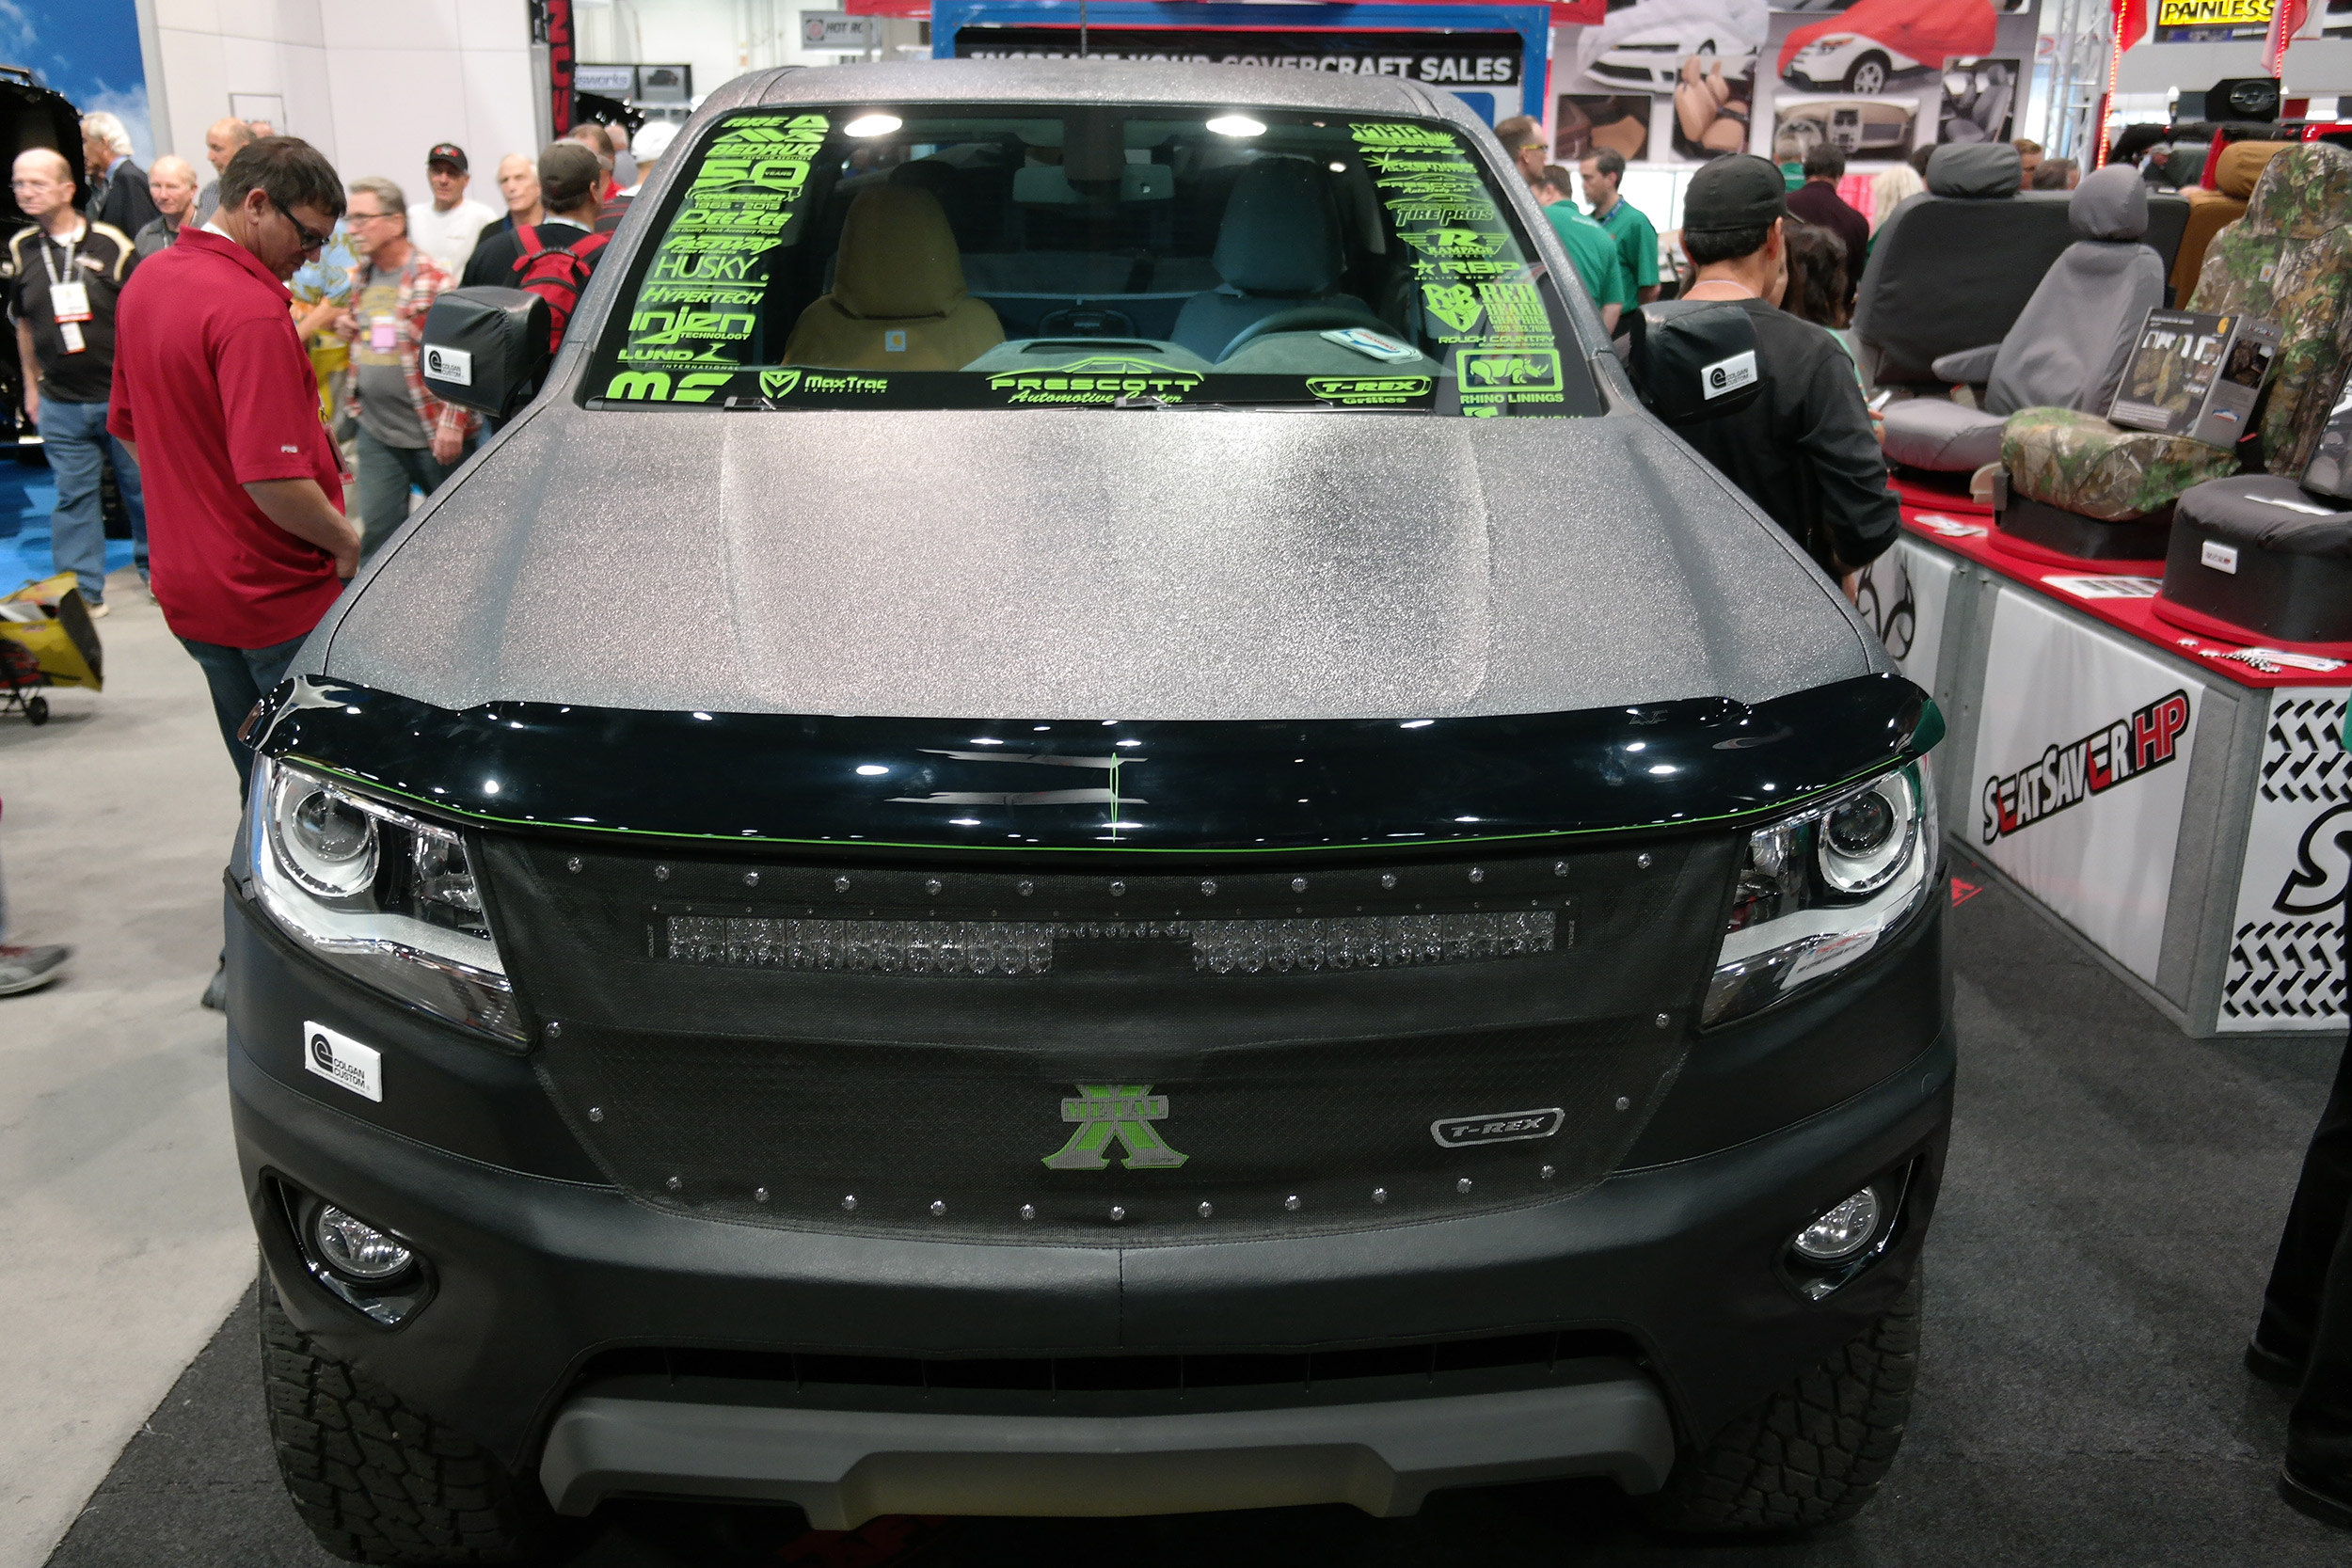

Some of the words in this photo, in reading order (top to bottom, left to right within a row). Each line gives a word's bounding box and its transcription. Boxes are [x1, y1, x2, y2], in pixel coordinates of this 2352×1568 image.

[1420, 56, 1513, 82] SALES
[704, 143, 822, 157] BEDRUG
[1359, 146, 1465, 155] NITTO
[693, 160, 811, 188] 50
[1395, 209, 1440, 228] TIRE
[1439, 208, 1494, 227] PROS
[1427, 246, 1495, 255] RAMPAGE
[654, 255, 759, 280] HUSKY
[1438, 261, 1520, 274] RBP
[640, 286, 765, 305] HYPERTECH
[1475, 283, 1538, 303] RED
[1483, 302, 1546, 316] BEARD
[1488, 315, 1550, 325] GRAPHICS
[680, 332, 751, 341] TECHNOLOGY
[1438, 335, 1486, 344] ROUGH
[1489, 334, 1555, 343] COUNTRY
[617, 349, 694, 361] LUND
[804, 375, 888, 389] MaxTrac
[992, 379, 1199, 392] PRESCOTT
[1322, 381, 1417, 392] T-REX
[1008, 390, 1115, 404] Automotive
[1460, 394, 1505, 404] RHINO
[1508, 393, 1565, 404] LININGS
[2134, 691, 2189, 770] HP
[333, 1058, 365, 1080] COLGAN
[333, 1068, 366, 1088] CUSTOM
[1452, 1117, 1545, 1138] T-REX
